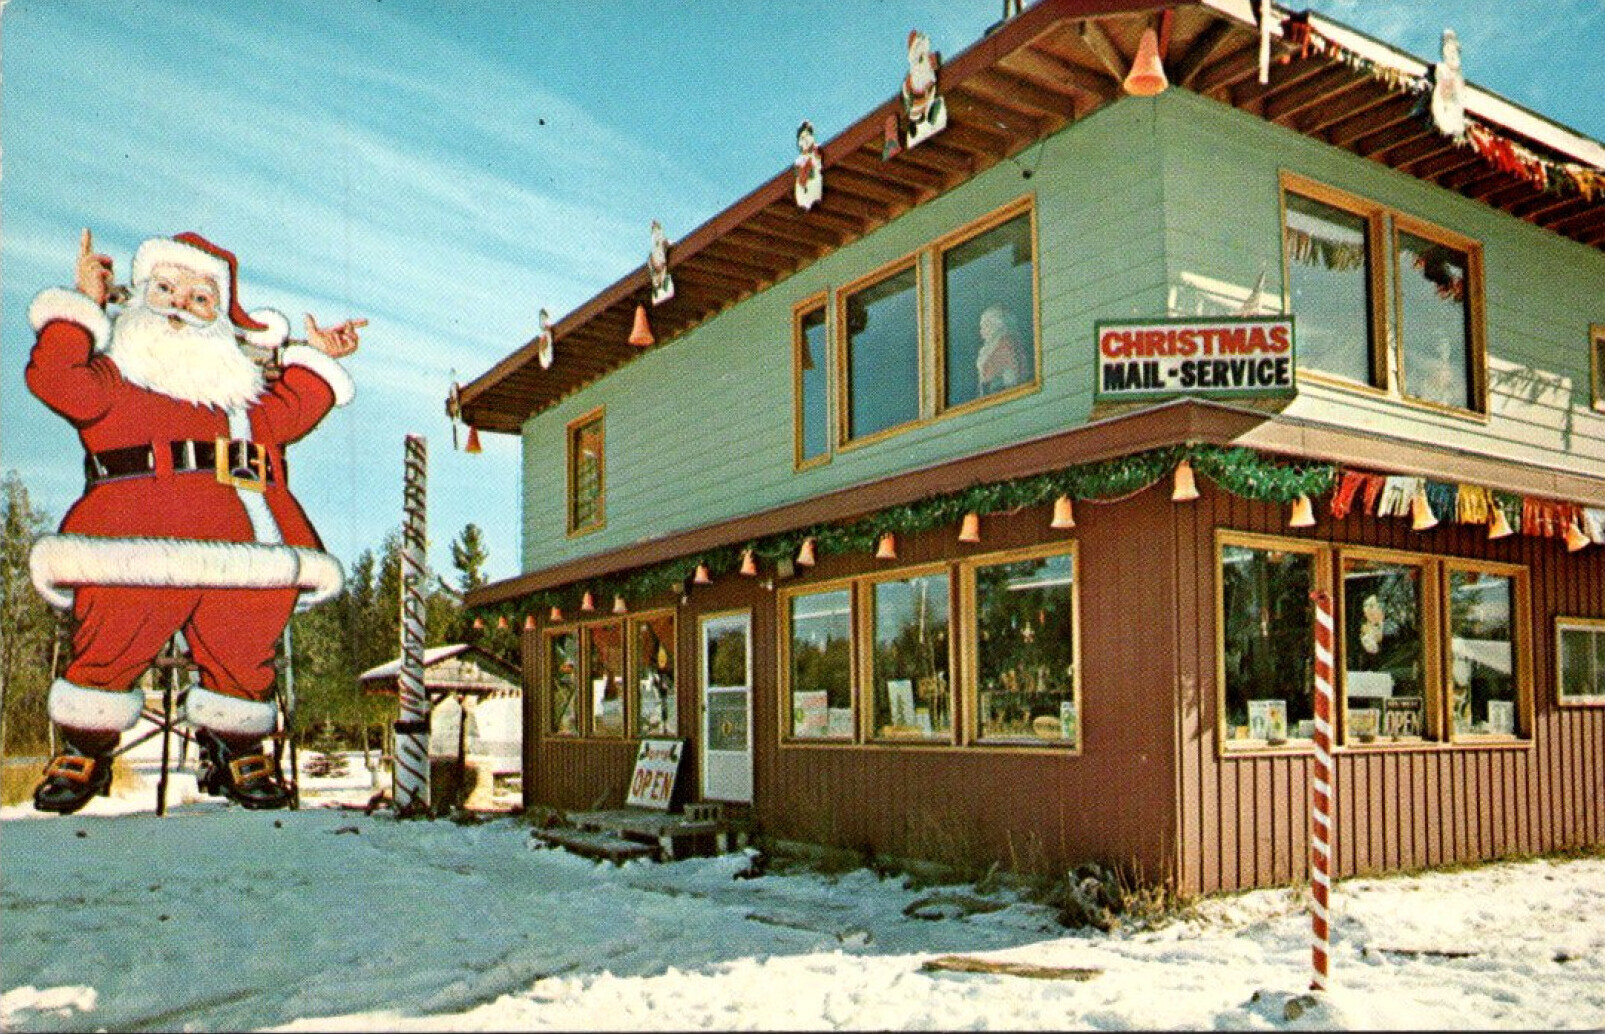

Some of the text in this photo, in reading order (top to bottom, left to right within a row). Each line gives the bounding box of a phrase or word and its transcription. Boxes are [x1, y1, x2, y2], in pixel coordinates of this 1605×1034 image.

[1101, 326, 1290, 358] CHRISTMAS
[1386, 710, 1421, 735] OPEN
[632, 768, 673, 799] OPEN
